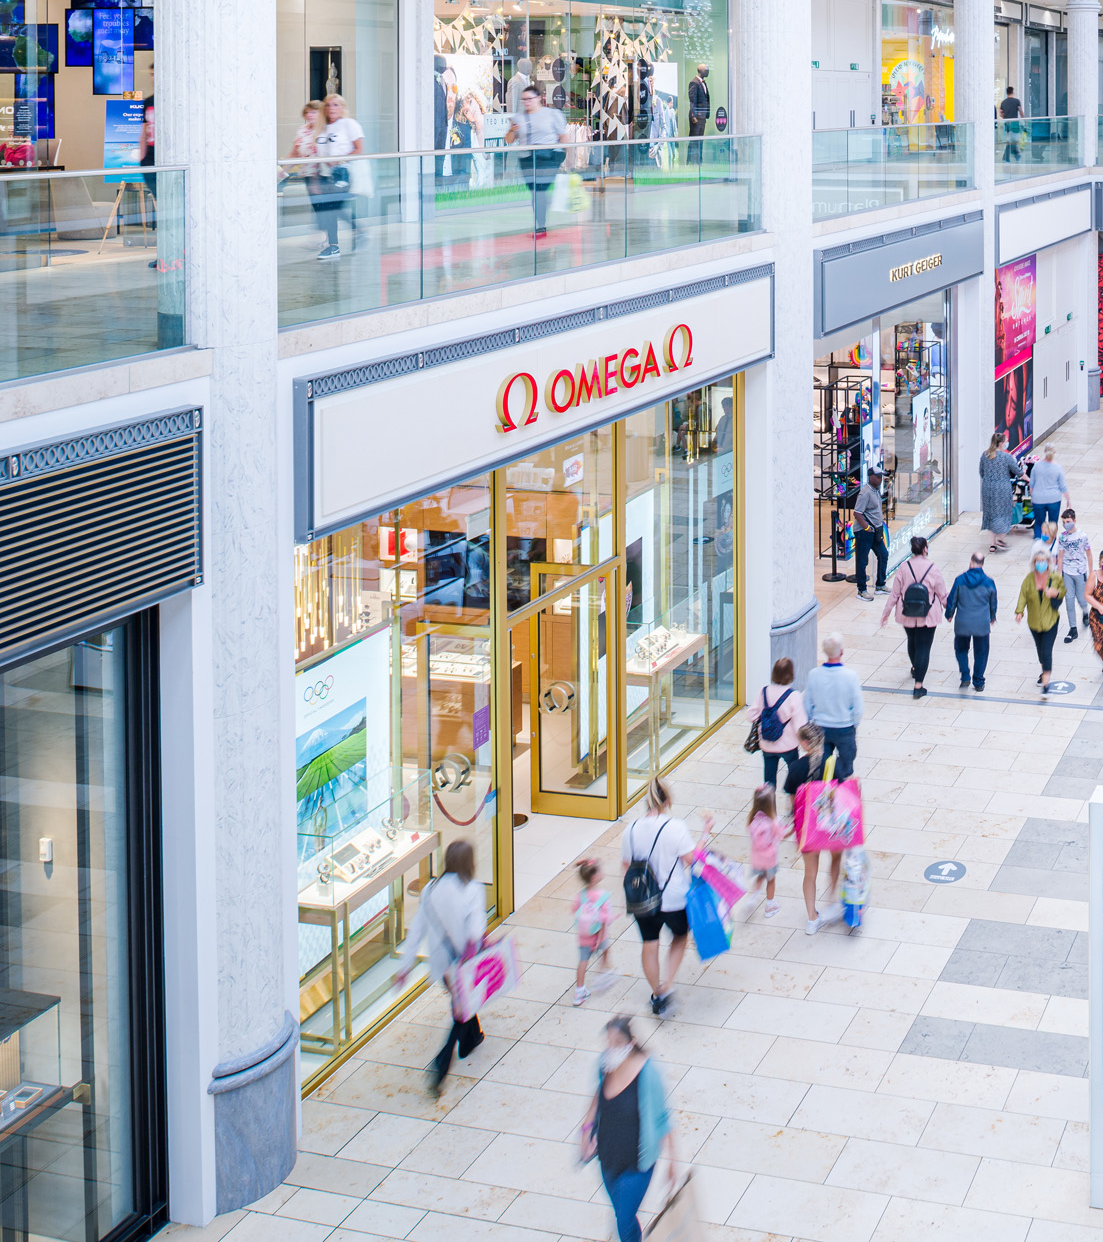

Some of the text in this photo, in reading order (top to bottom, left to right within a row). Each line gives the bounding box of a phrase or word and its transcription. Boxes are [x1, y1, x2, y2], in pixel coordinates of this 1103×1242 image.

[102, 19, 129, 27] troubes
[890, 254, 943, 282] KURT GEIGER
[545, 340, 661, 414] OMEGA
